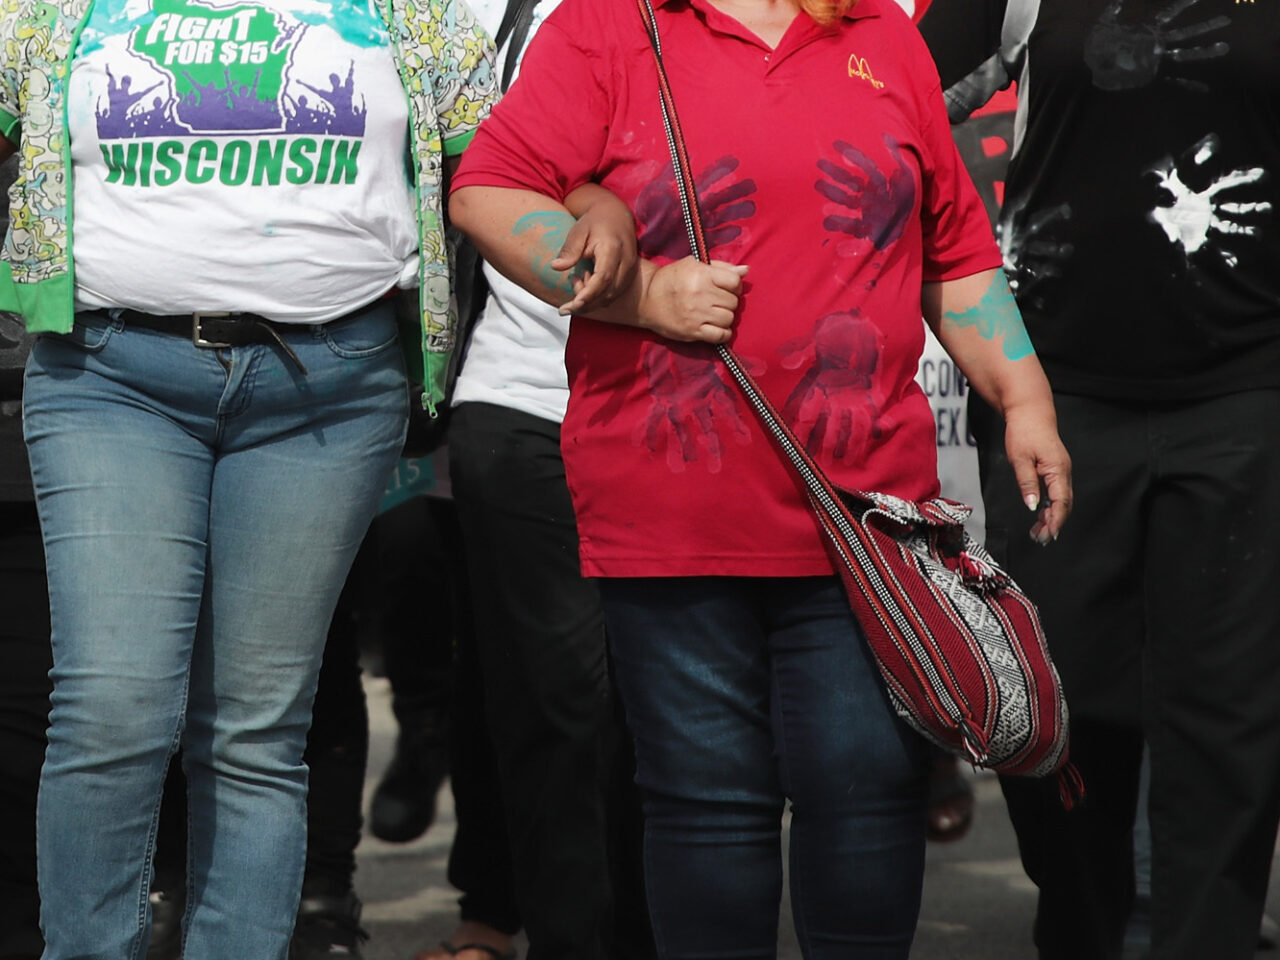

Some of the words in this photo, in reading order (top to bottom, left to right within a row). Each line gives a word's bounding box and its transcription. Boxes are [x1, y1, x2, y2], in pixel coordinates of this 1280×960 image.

[145, 8, 258, 46] FIGHT
[164, 41, 215, 66] FOR
[218, 40, 270, 66] $15
[98, 137, 363, 188] WISCONSIN
